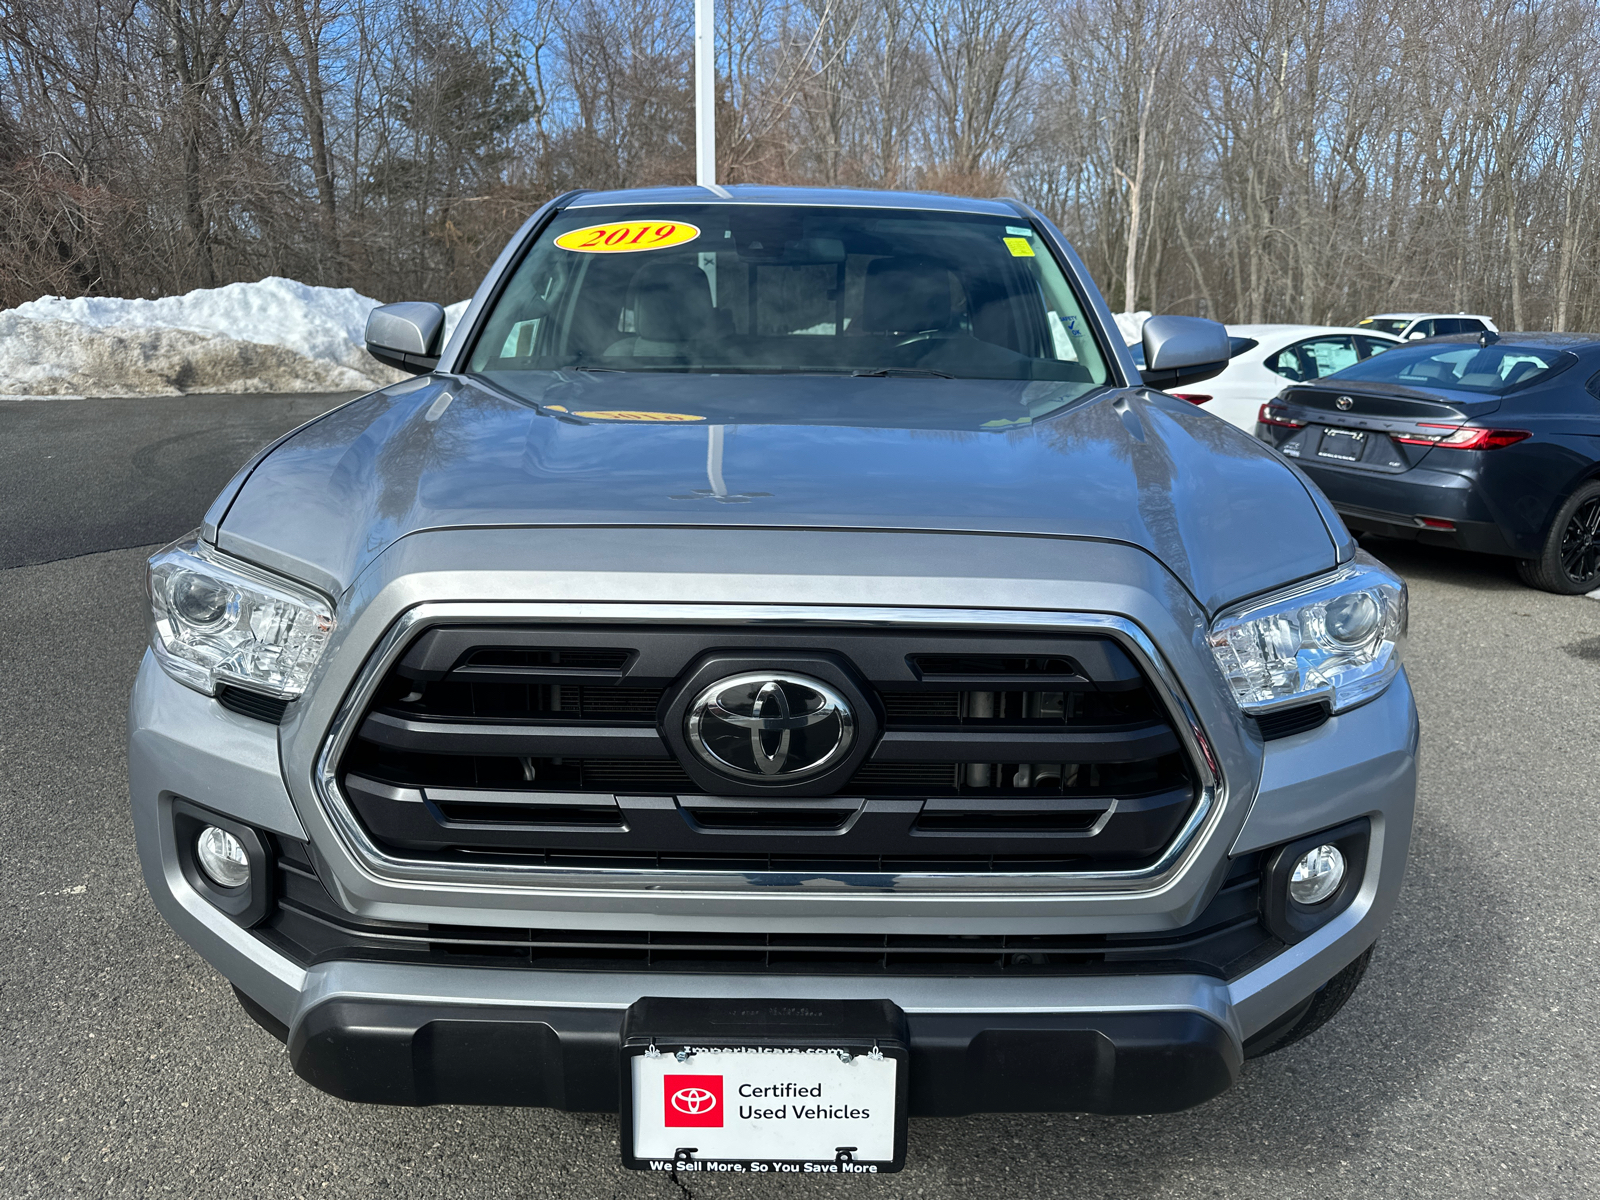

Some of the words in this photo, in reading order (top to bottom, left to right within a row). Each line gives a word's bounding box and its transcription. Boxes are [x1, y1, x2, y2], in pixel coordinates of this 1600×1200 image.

[578, 224, 676, 248] 2019
[738, 1082, 822, 1098] Certified
[739, 1104, 787, 1120] Used
[791, 1104, 870, 1120] Vehicles
[649, 1161, 673, 1171] We
[676, 1161, 702, 1171] Sell
[706, 1161, 747, 1174] More,
[750, 1161, 769, 1172] So
[772, 1162, 800, 1173] You
[803, 1162, 838, 1173] Save
[841, 1162, 878, 1173] More
